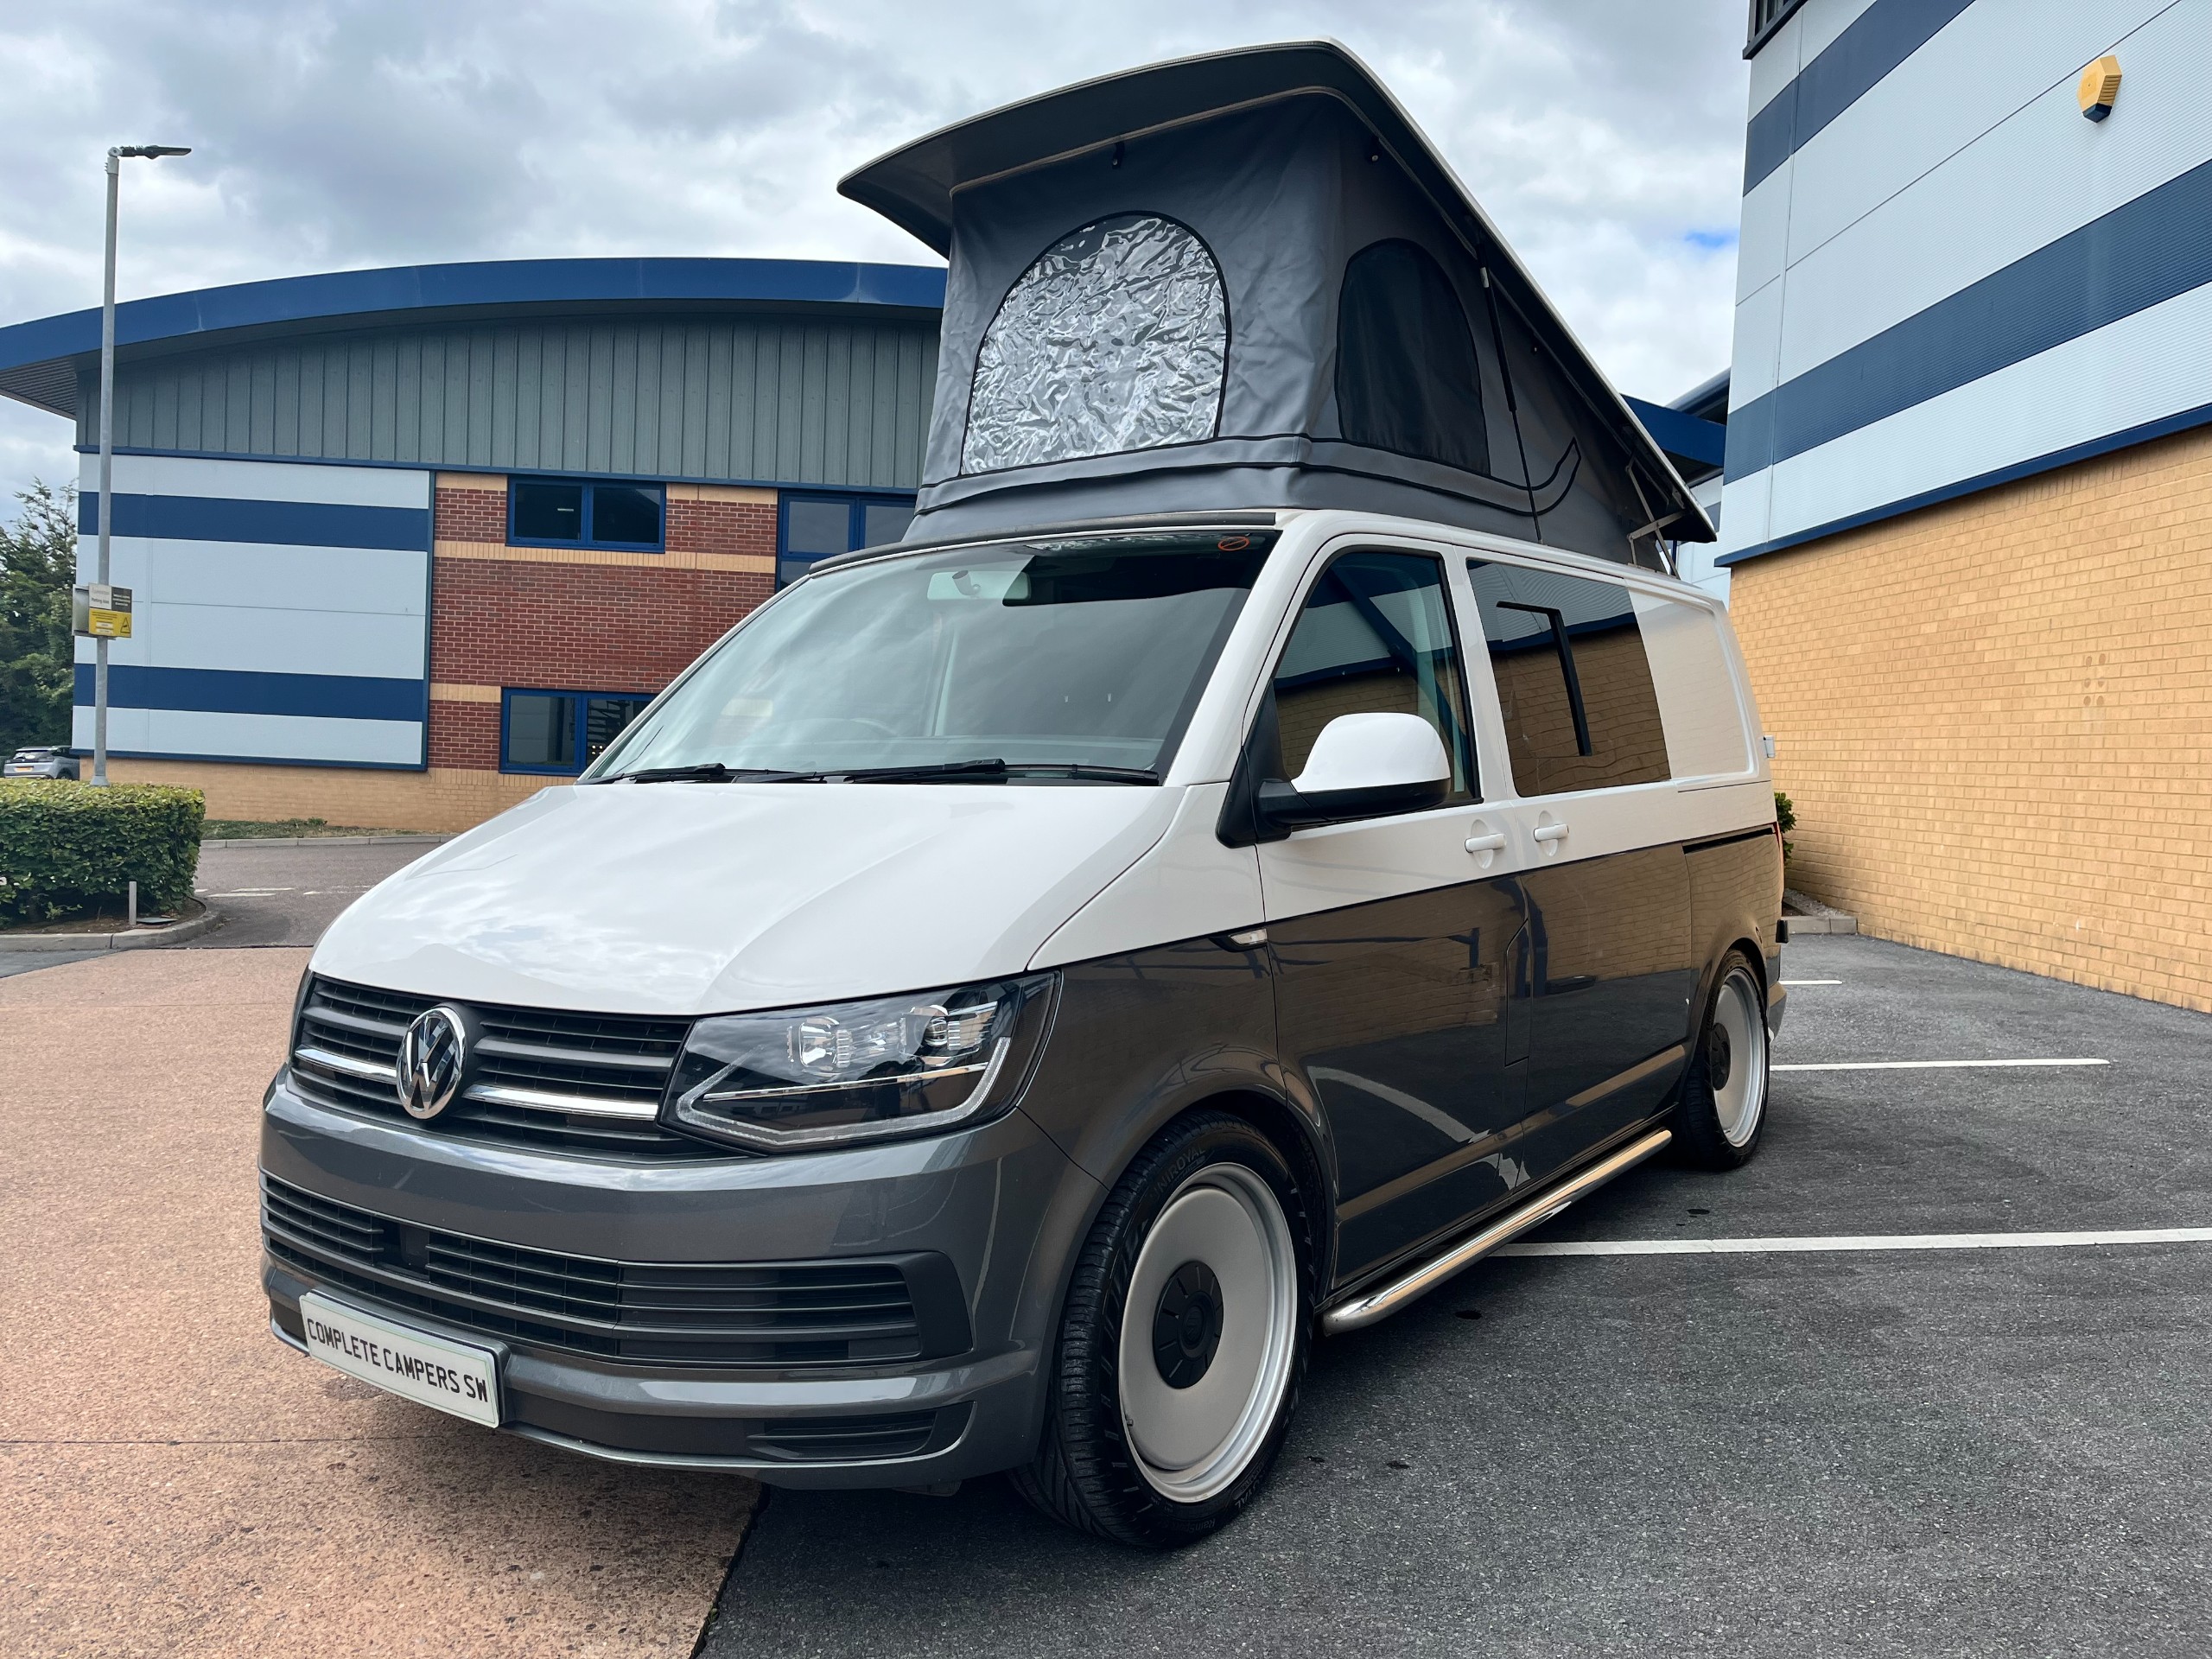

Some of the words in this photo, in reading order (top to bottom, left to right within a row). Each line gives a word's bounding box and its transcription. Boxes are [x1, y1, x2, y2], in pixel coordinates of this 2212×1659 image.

[307, 1318, 381, 1367] COMPLETE
[384, 1348, 460, 1394] CAMPERS
[463, 1374, 488, 1402] SW
